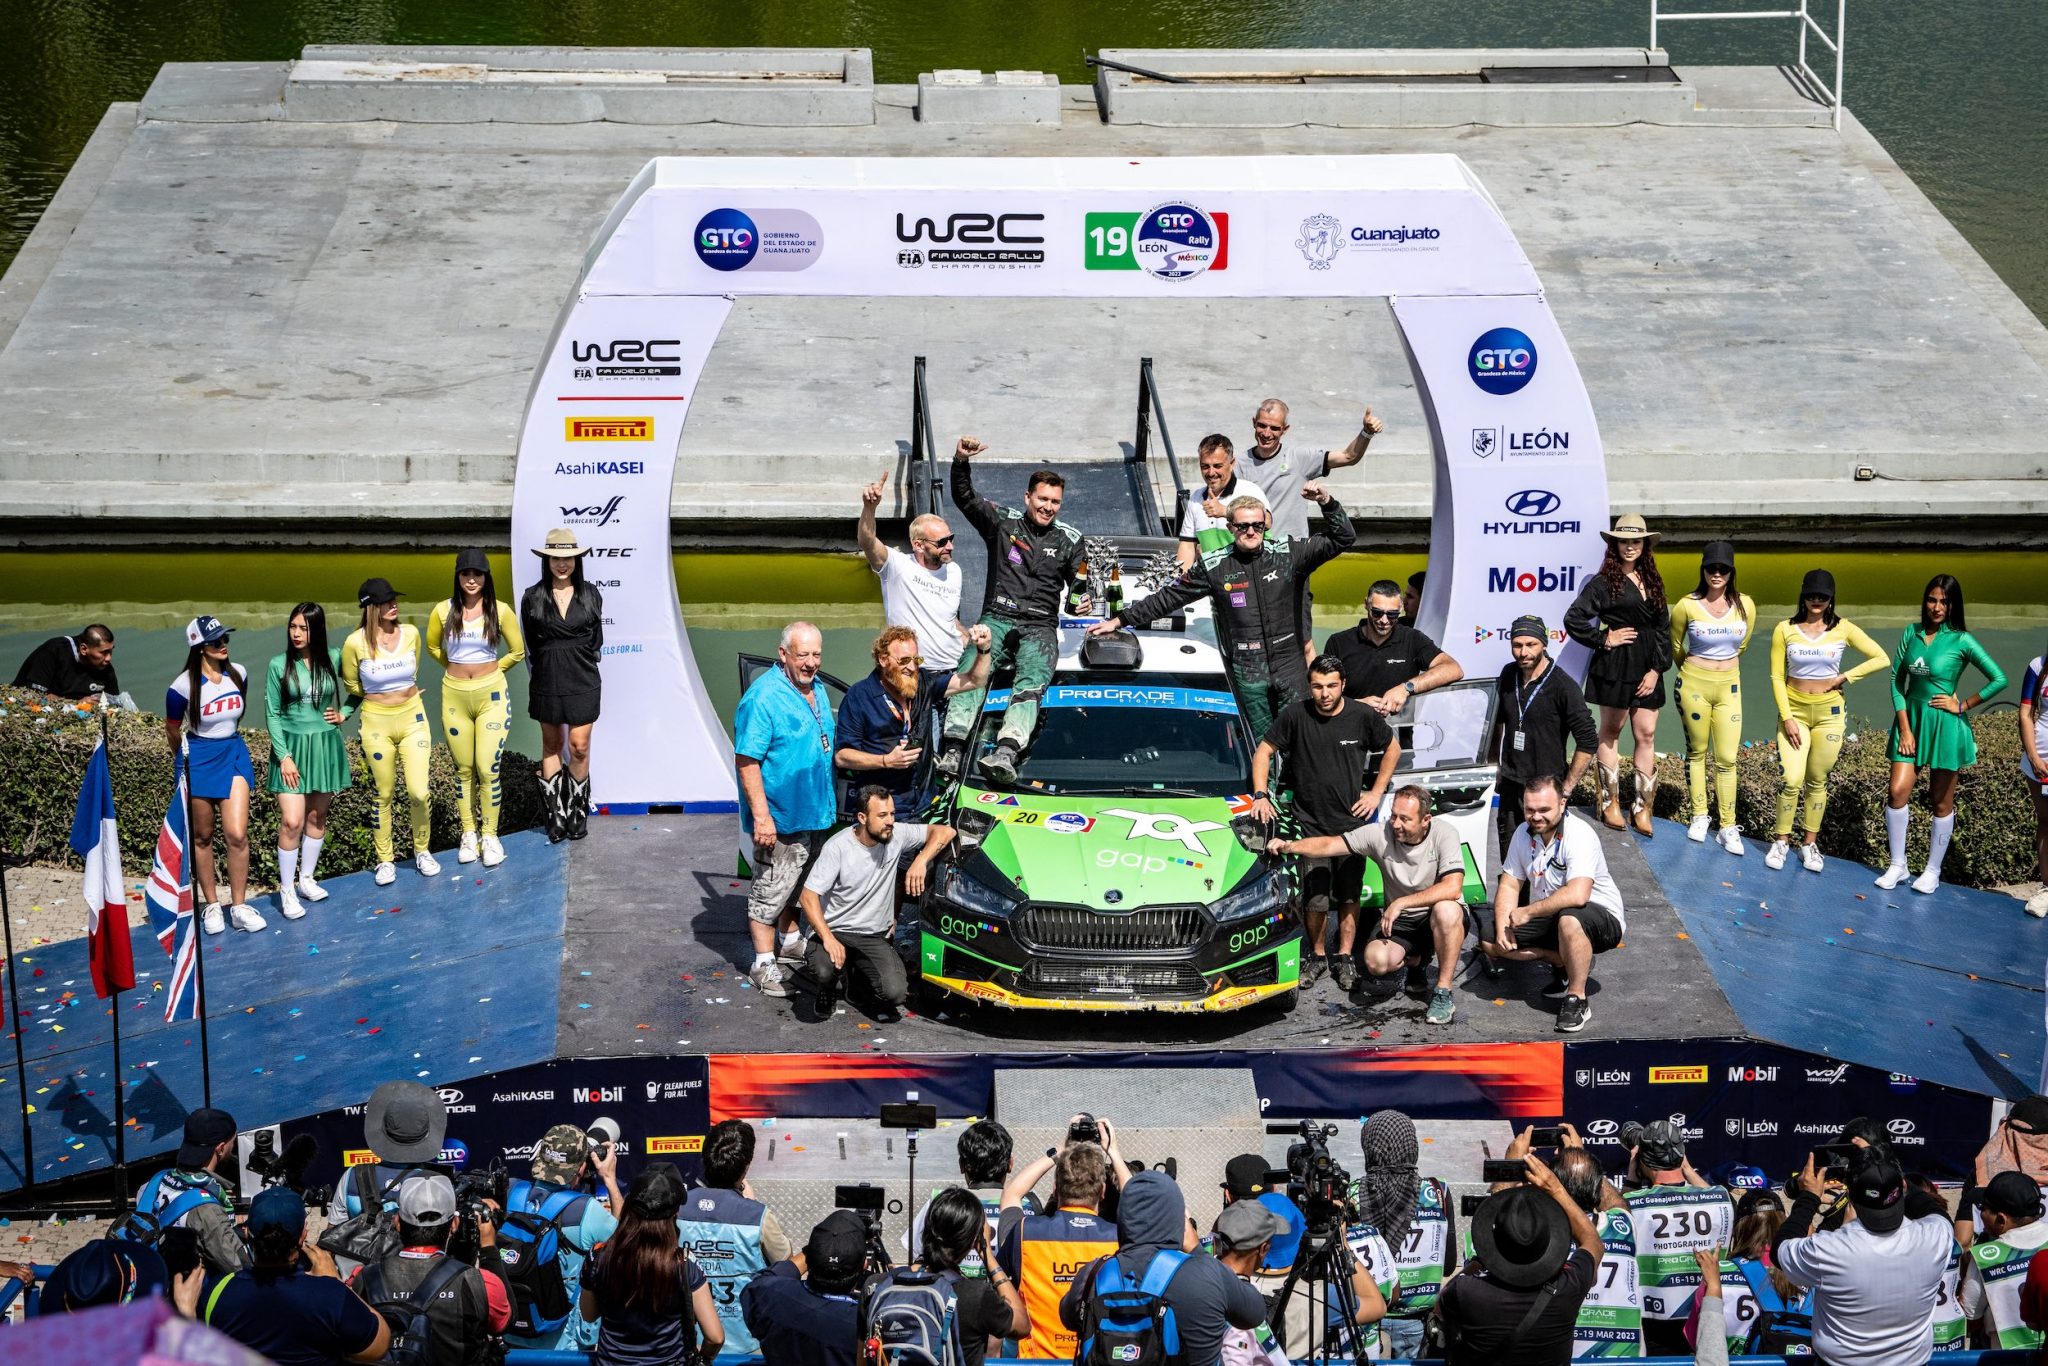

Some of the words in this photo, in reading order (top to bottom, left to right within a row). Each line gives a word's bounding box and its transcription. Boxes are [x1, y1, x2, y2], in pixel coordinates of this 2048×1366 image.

[1157, 213, 1195, 228] GTO
[896, 212, 1045, 244] WRC
[1351, 225, 1440, 243] Guanajuato
[701, 228, 753, 248] GTO
[1089, 226, 1128, 257] 19
[1188, 235, 1210, 246] Rally
[1139, 241, 1168, 253] LEÓN
[930, 252, 950, 260] FIA
[952, 252, 997, 260] WORLD
[999, 252, 1042, 260] RALLY
[572, 340, 681, 362] WRC
[1475, 348, 1531, 370] GTO
[574, 421, 647, 437] PIRELLI
[1510, 427, 1569, 450] LEÓN
[1483, 520, 1581, 535] HYUNDAI
[583, 547, 633, 558] ATEC
[1488, 565, 1576, 593] Mobil
[616, 645, 630, 655] FOR
[631, 644, 643, 653] ALL
[203, 696, 241, 717] LTH
[981, 794, 996, 802] E
[1013, 812, 1039, 824] 20
[1095, 849, 1167, 874] gap
[940, 914, 979, 941] gap
[1229, 925, 1268, 953] gap
[1597, 1068, 1631, 1082] LEÓN
[1655, 1069, 1703, 1081] PIRELLI
[1728, 1066, 1777, 1082] Mobil
[664, 1081, 684, 1091] CLEAN
[684, 1080, 702, 1089] FUELS
[573, 1086, 623, 1104] Mobil
[664, 1090, 675, 1099] FOR
[675, 1089, 688, 1098] ALL
[343, 1106, 361, 1116] TW
[1747, 1120, 1778, 1133] LEÓN
[1794, 1123, 1845, 1134] AsahiKAS
[652, 1138, 701, 1151] PIRELLI
[437, 1148, 466, 1161] GTO
[1736, 1175, 1764, 1187] GTO
[1629, 1198, 1645, 1207] WRC
[1645, 1194, 1683, 1206] Guanajuato
[1683, 1193, 1701, 1204] Rally
[1702, 1192, 1723, 1202] Mexico
[1417, 1209, 1441, 1218] Mexico
[1651, 1210, 1713, 1240] 230
[1611, 1242, 1632, 1253] Mexico
[1989, 1268, 2006, 1278] WRC
[1670, 1275, 1696, 1285] 16-19
[1401, 1288, 1416, 1296] MAR
[1416, 1285, 1437, 1294] 2023
[1736, 1294, 1755, 1322] 6
[1596, 1331, 1614, 1340] MAR
[1615, 1332, 1636, 1341] 2023
